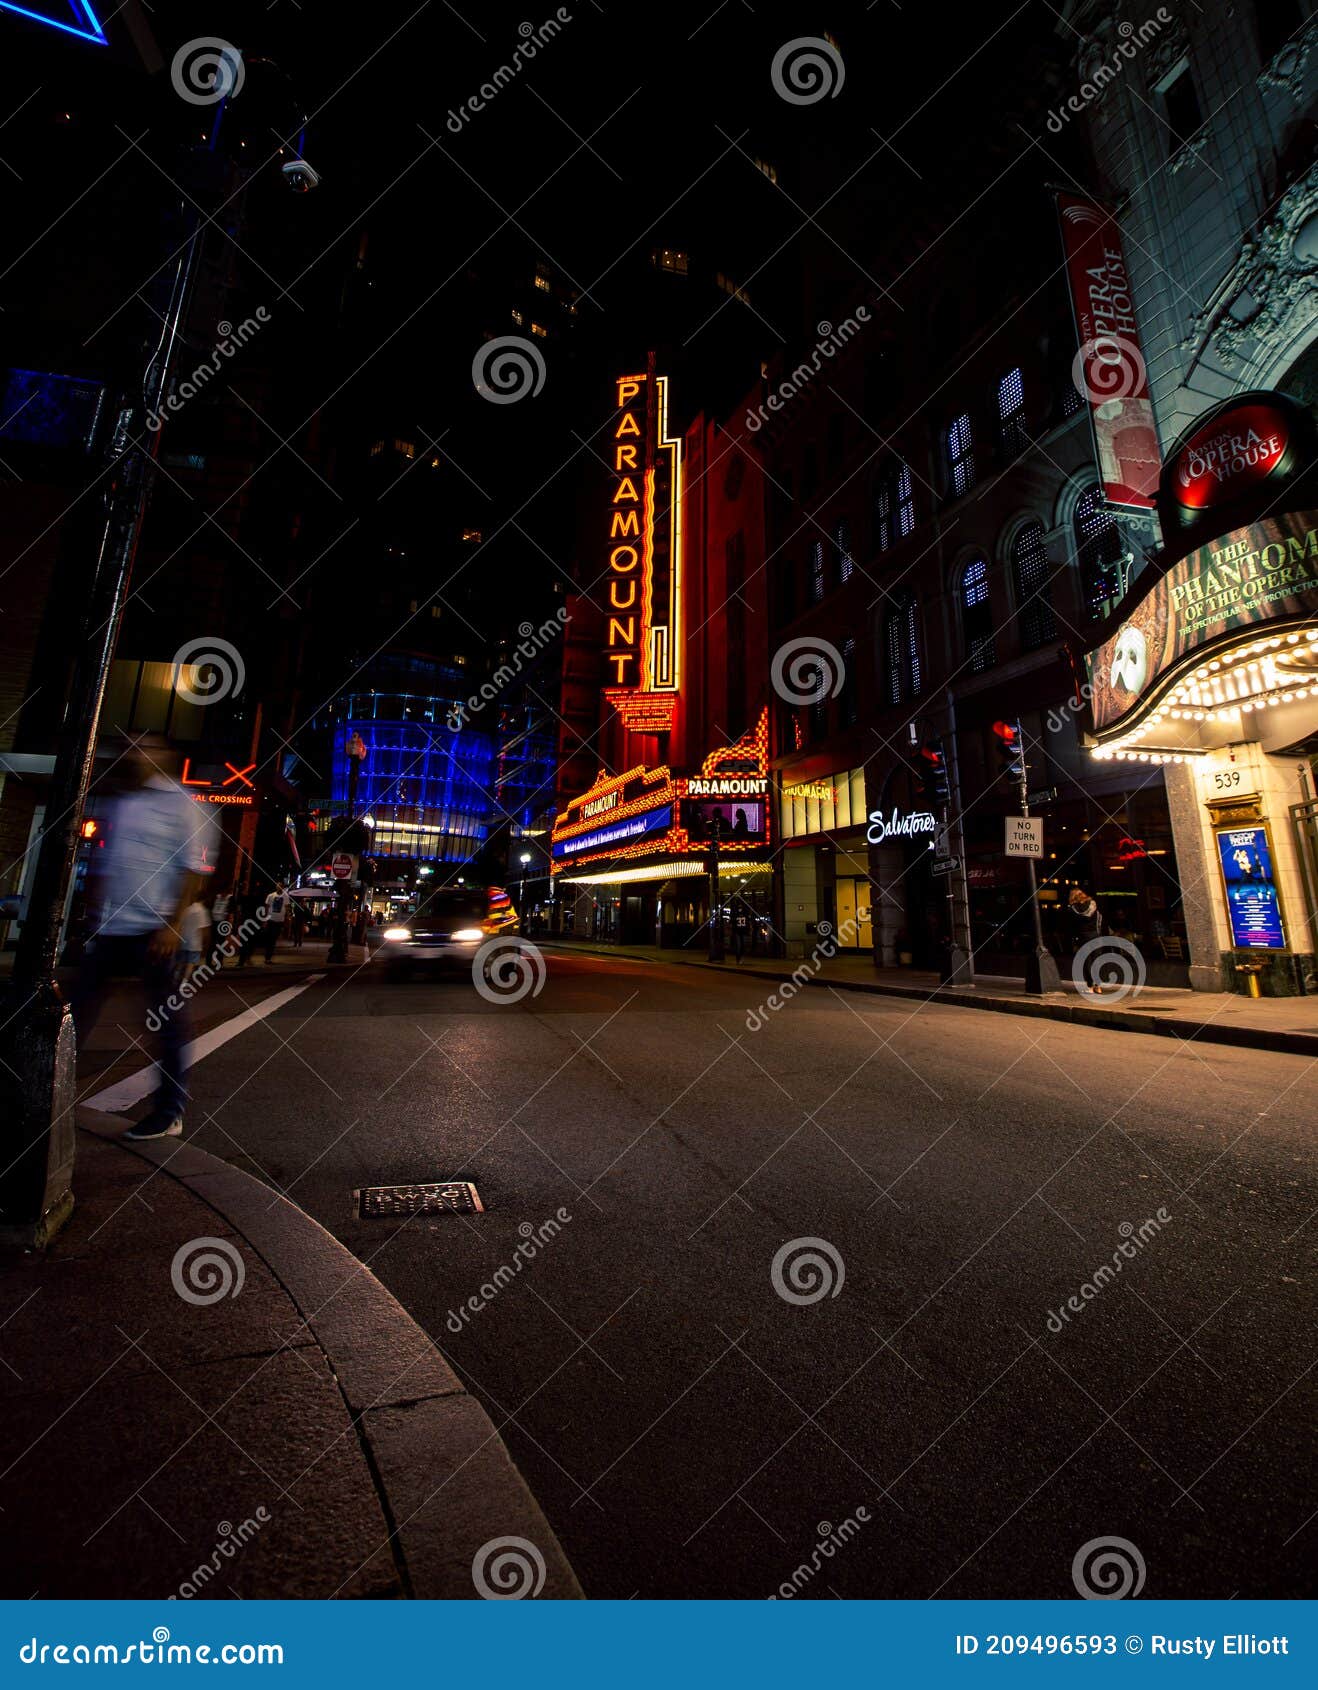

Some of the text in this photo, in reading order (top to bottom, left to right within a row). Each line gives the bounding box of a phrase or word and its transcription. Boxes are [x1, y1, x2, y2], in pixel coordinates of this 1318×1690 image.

[1104, 248, 1136, 334] HOUSE
[1087, 266, 1122, 366] OPERA
[1189, 428, 1262, 478] OPERA
[1217, 436, 1281, 482] HOUSE
[609, 382, 640, 684] PARAMOUNT
[1212, 539, 1250, 566] THE
[1169, 529, 1318, 613] PHANTOM
[1185, 564, 1310, 621] OF THE OPERA
[1193, 606, 1242, 631] SPECTACULAR
[1244, 598, 1262, 611] NEW
[182, 758, 256, 788] LX
[689, 779, 767, 794] PARAMOUNT
[1214, 771, 1240, 789] 539
[208, 795, 253, 804] CROSSING
[584, 791, 618, 819] PARAMOUNT
[1013, 832, 1035, 841] TURN
[1017, 821, 1032, 830] NO
[1008, 842, 1040, 852] ON RED
